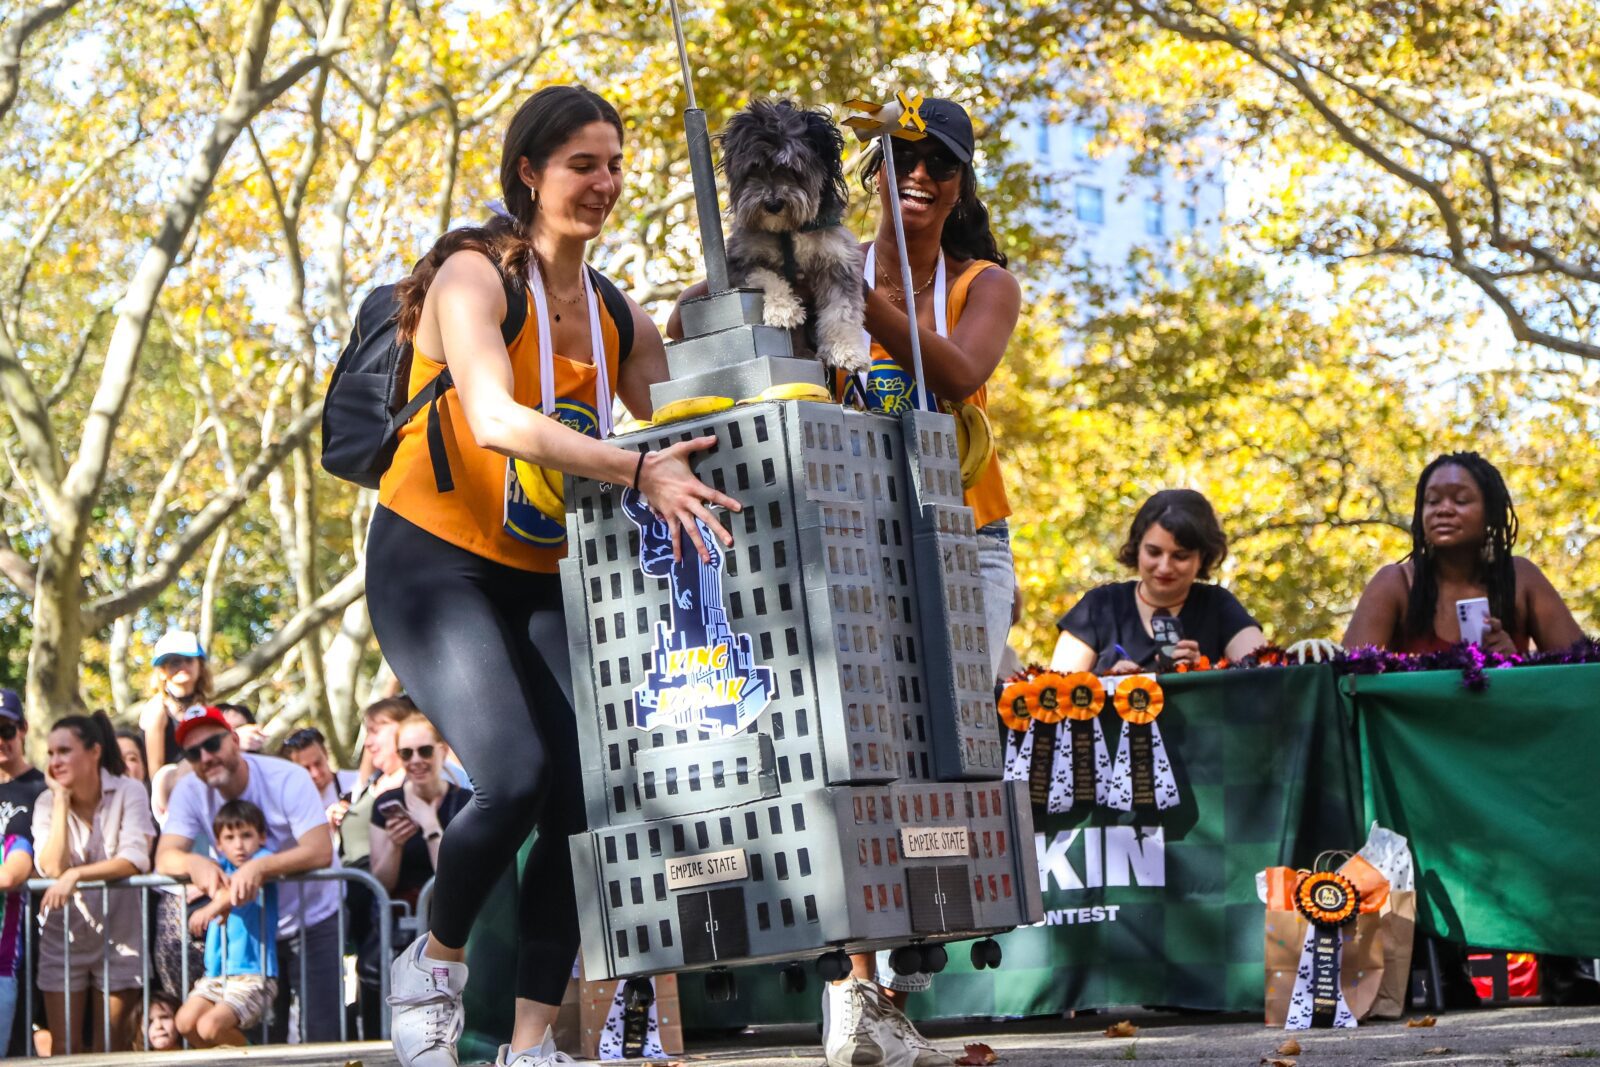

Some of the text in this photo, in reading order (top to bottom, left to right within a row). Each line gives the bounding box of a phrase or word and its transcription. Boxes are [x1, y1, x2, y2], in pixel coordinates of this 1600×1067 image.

[668, 643, 730, 678] KING
[908, 831, 966, 852] EMPIRE STATE
[670, 855, 737, 880] EMPIRE STATE
[1017, 905, 1120, 929] NTEST
